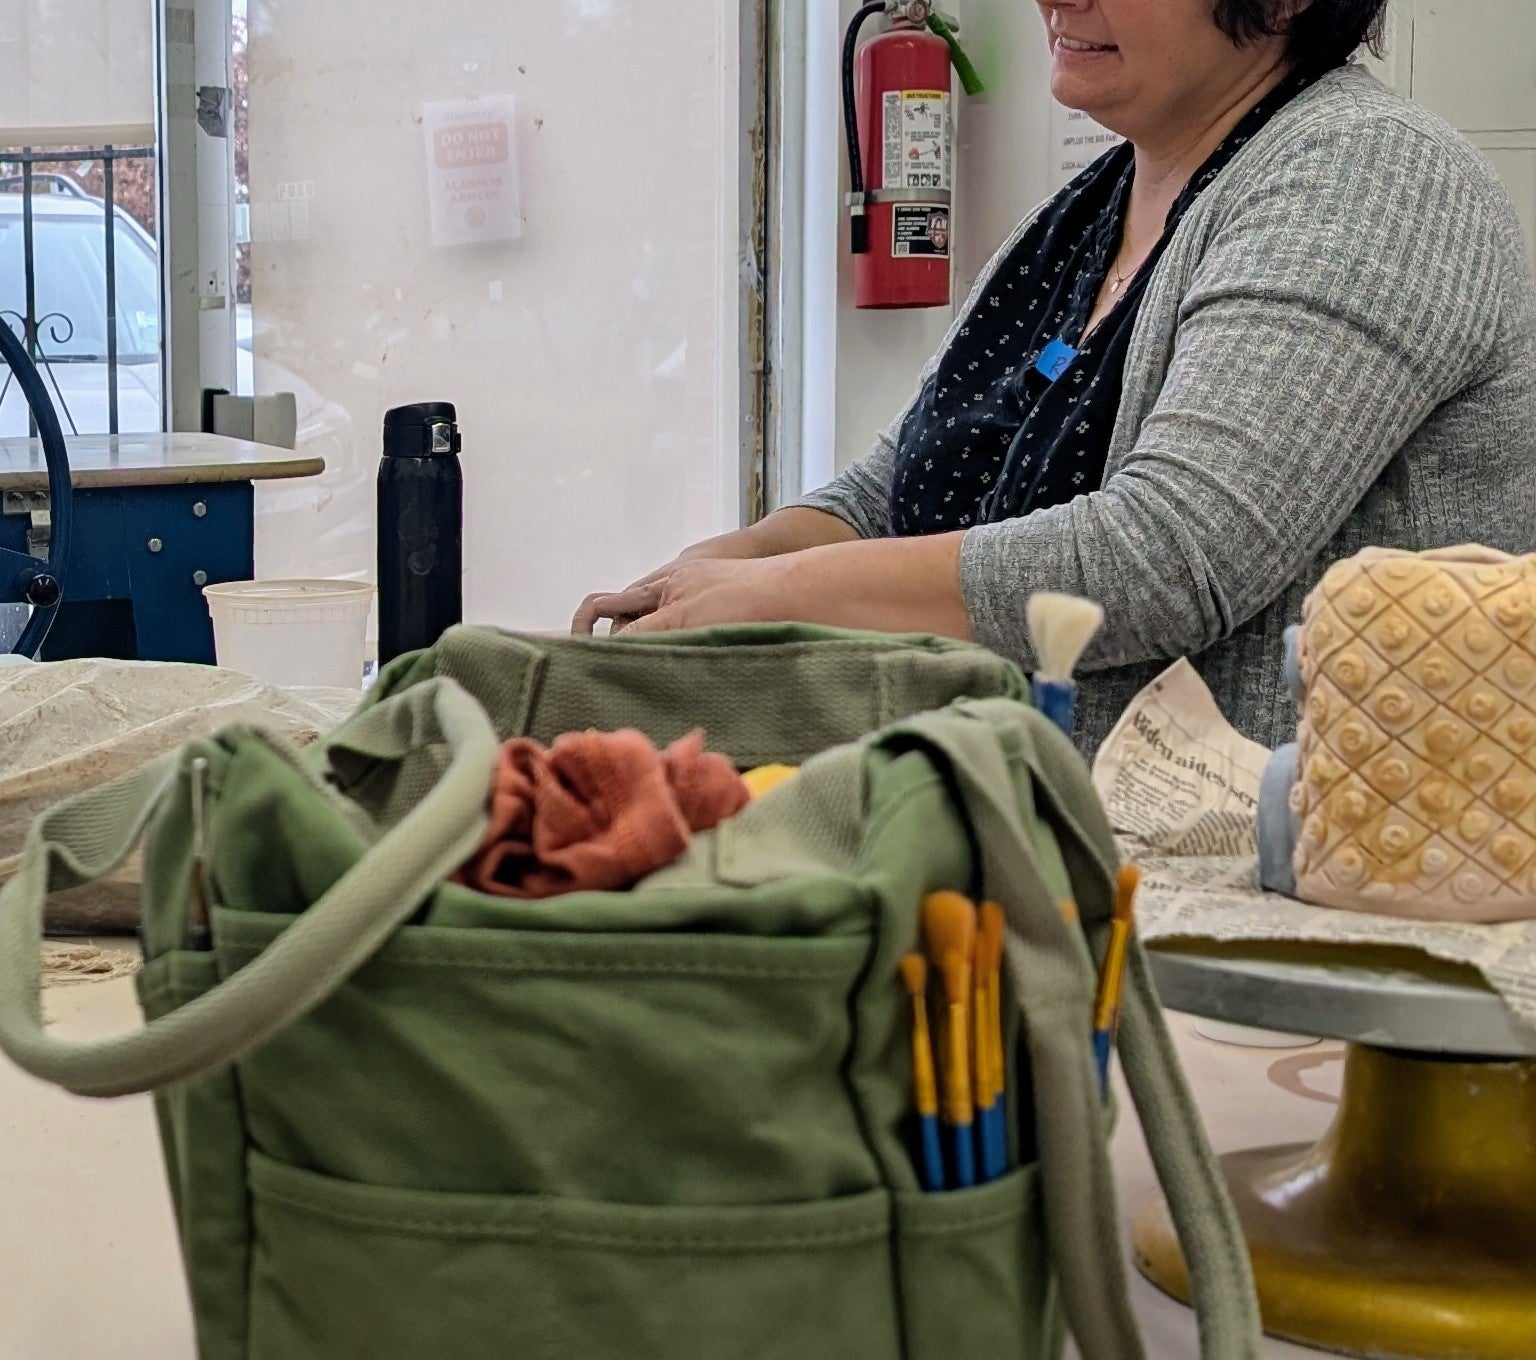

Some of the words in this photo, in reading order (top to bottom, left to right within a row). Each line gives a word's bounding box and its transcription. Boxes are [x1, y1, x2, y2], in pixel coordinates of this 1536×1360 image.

[441, 132, 463, 147] DO
[468, 127, 500, 145] NOT
[446, 145, 497, 163] ENTER
[1175, 756, 1226, 787] aides
